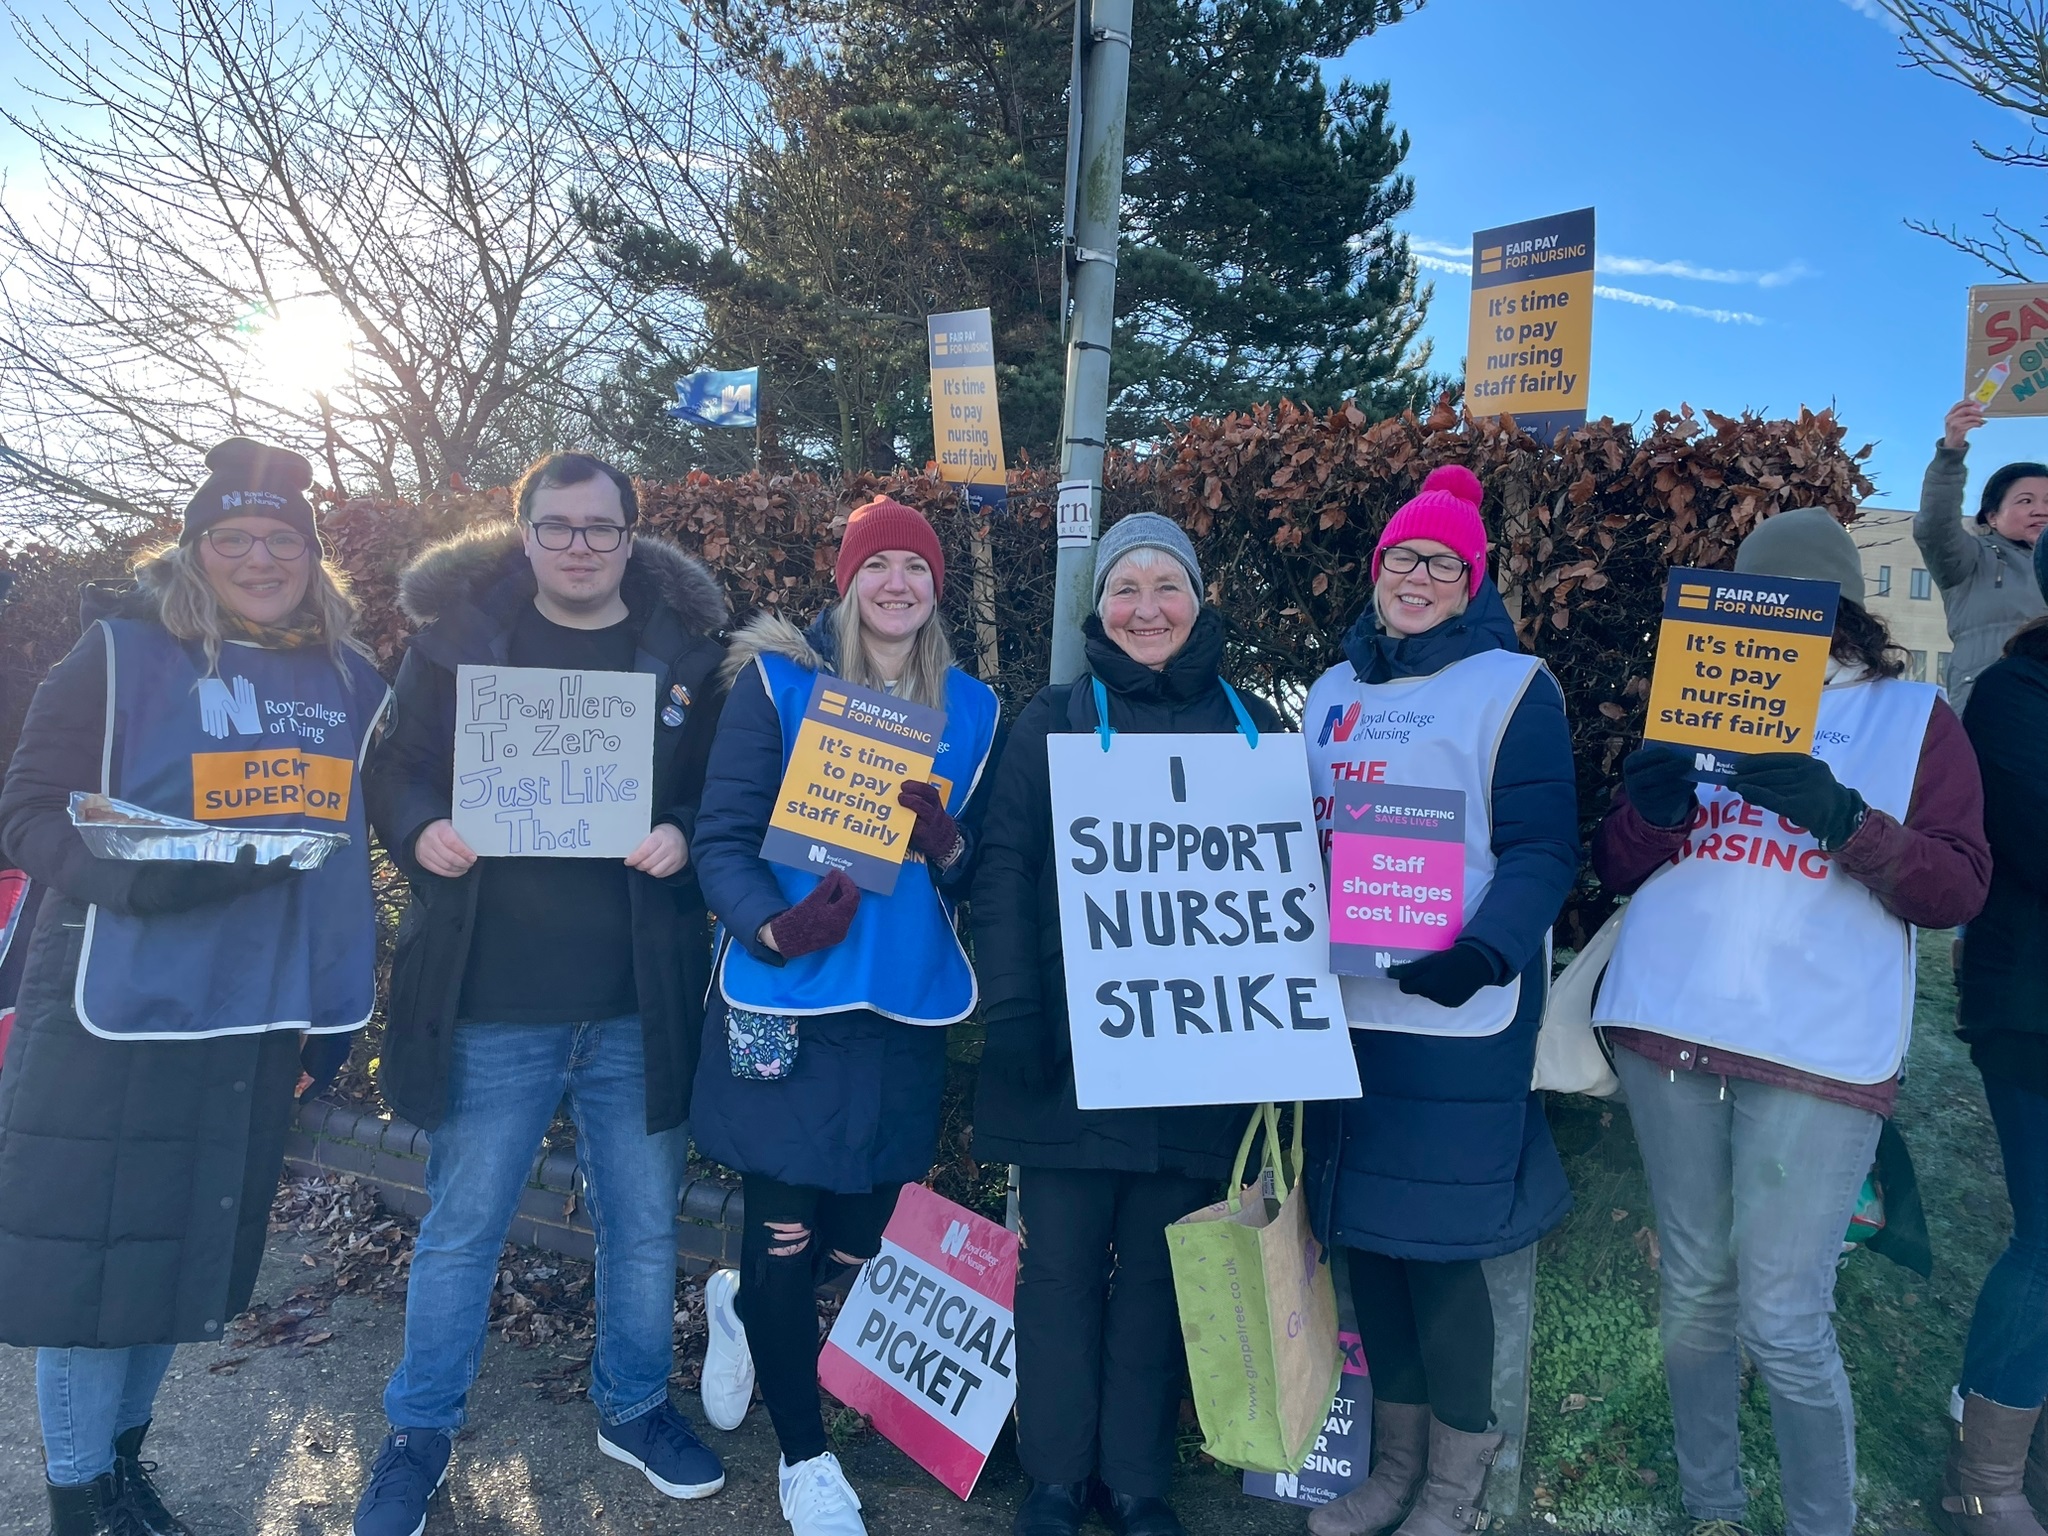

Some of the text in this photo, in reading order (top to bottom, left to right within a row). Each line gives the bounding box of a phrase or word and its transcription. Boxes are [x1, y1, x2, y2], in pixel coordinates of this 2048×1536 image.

[1505, 244, 1586, 269] FOR NURSING
[1506, 234, 1558, 256] FAIR PAY
[1489, 290, 1569, 317] It's time
[949, 331, 976, 342] FAIR PAY
[1495, 321, 1558, 344] to pay
[949, 342, 989, 354] FOR NURSING
[1487, 344, 1563, 370] nursing
[944, 377, 985, 395] It's time
[1474, 370, 1577, 397] staff fairly
[950, 404, 982, 423] to pay
[948, 424, 988, 447] nursing
[942, 448, 997, 470] staff fairly
[1059, 502, 1092, 523] rn
[1716, 587, 1790, 605] FAIR PAY
[1714, 600, 1823, 622] FOR NURSING
[1686, 634, 1799, 663] It's time
[1695, 661, 1781, 690] to pay
[560, 675, 636, 719] Hero
[1681, 686, 1786, 717] nursing
[265, 700, 346, 727] Roy College
[850, 699, 908, 724] FAIR PAY
[1388, 711, 1435, 727] College
[270, 718, 285, 734] of
[847, 711, 932, 743] FOR NURSING
[1353, 728, 1410, 744] of Nursing
[1660, 708, 1801, 744] staff fairly
[1814, 730, 1850, 744] llege
[465, 723, 621, 762] To Zero
[818, 735, 852, 758] It's
[858, 747, 908, 775] time
[823, 761, 892, 797] to pay
[1170, 756, 1187, 803] I
[1331, 761, 1387, 785] THE
[460, 767, 551, 809] Just
[807, 782, 892, 821] nursing
[1375, 804, 1455, 820] SAFE STAFFING
[495, 809, 590, 853] That
[786, 800, 900, 846] staff fairly
[1375, 814, 1439, 828] SAVES LIVES
[1069, 816, 1302, 875] SUPPORT
[1671, 833, 1832, 880] RSING
[1372, 853, 1425, 874] Staff
[1342, 877, 1452, 903] shortages
[1084, 882, 1316, 950] NURSES'
[1346, 905, 1448, 926] cost lives
[1096, 973, 1330, 1038] STRIKE
[869, 1256, 1015, 1379] OFFICIAL
[1222, 1257, 1258, 1422] www.grapetree.co.uk
[856, 1308, 983, 1417] PICKET
[1301, 1455, 1351, 1477] SING
